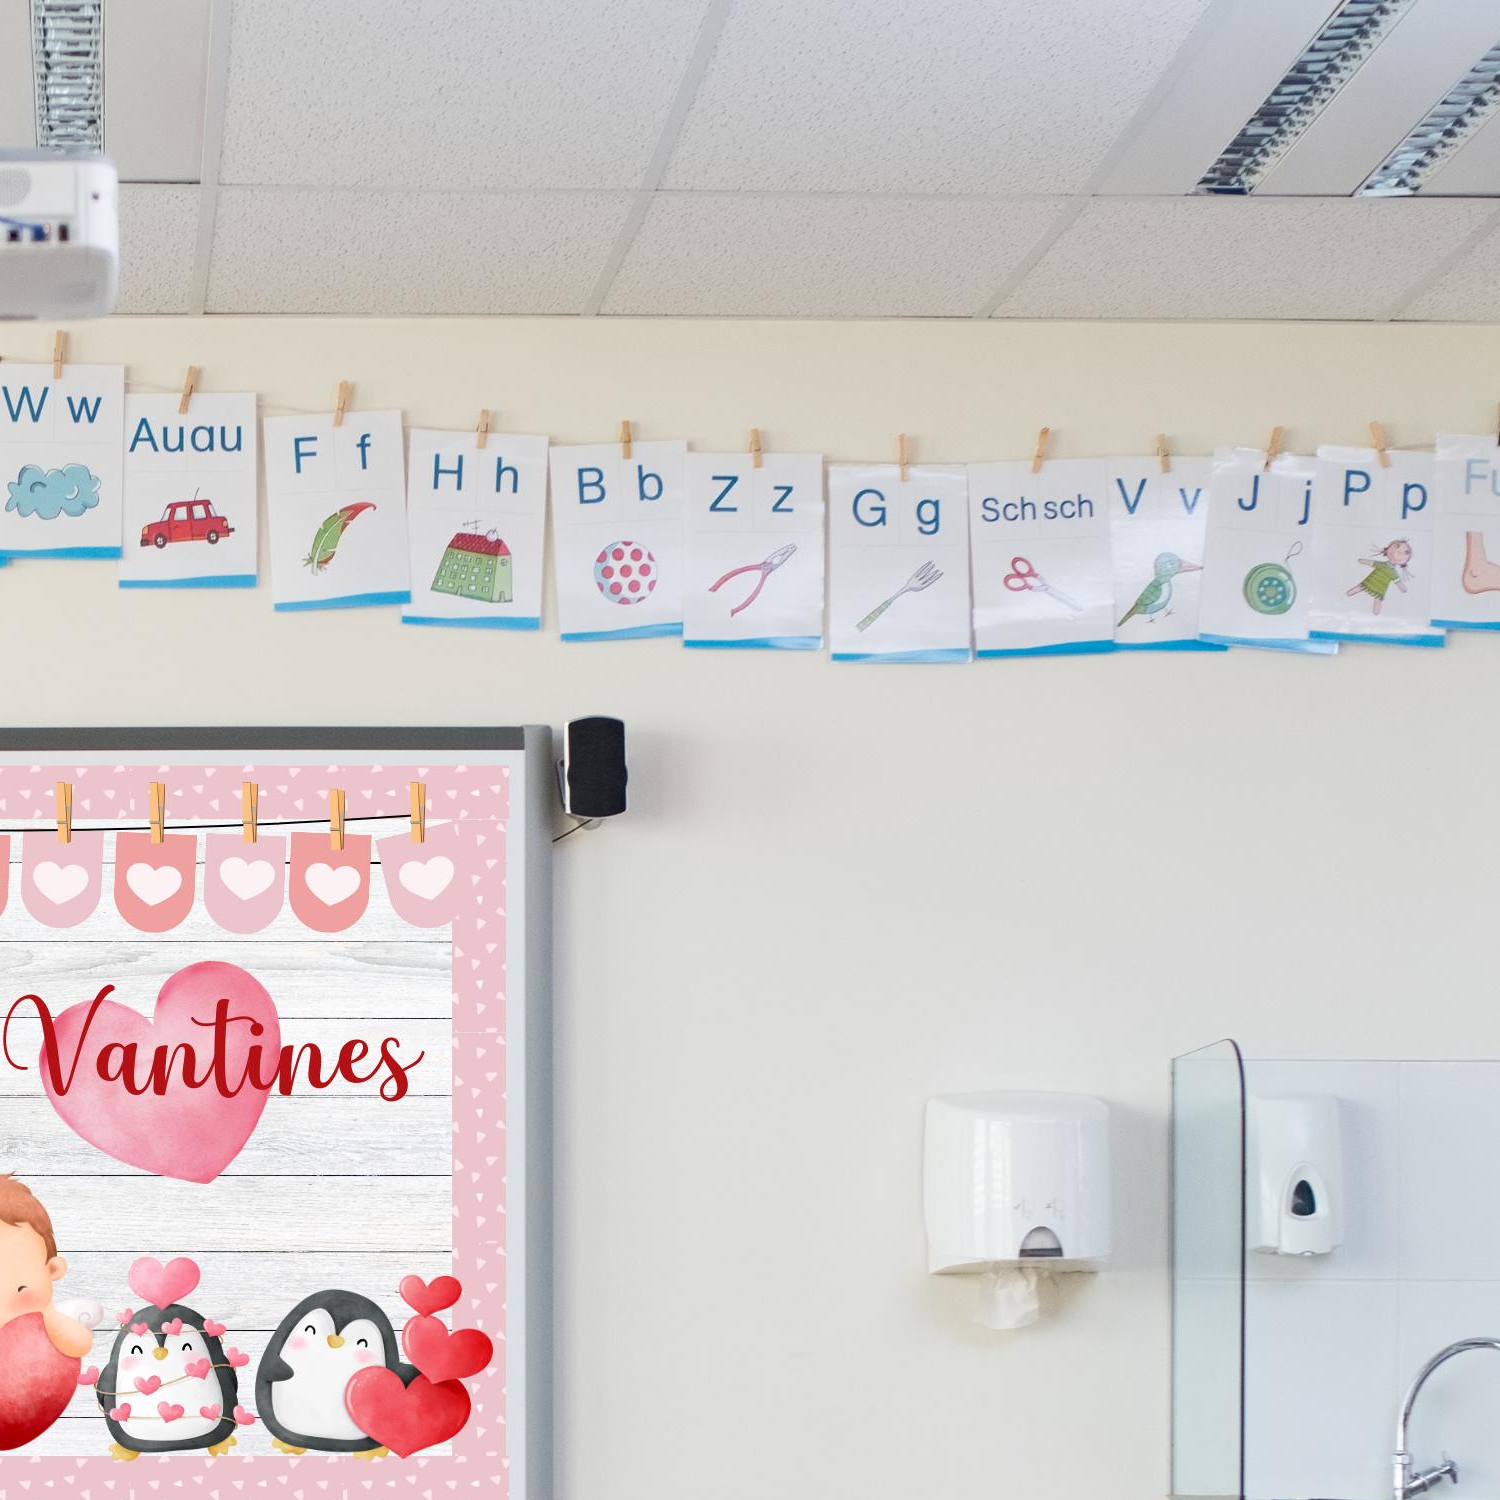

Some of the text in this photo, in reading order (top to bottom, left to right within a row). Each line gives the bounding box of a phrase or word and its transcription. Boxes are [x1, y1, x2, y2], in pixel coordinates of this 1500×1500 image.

[2, 386, 102, 423] W w
[293, 433, 372, 474] F f
[433, 453, 520, 494] H h
[577, 464, 665, 504] B b
[708, 475, 795, 513] Z z
[1116, 478, 1202, 515] V v
[1237, 474, 1312, 525] J j
[1343, 468, 1429, 520] P p
[852, 488, 941, 536] G g
[981, 493, 1094, 523] Sch sch
[2, 984, 426, 1104] Vantines
